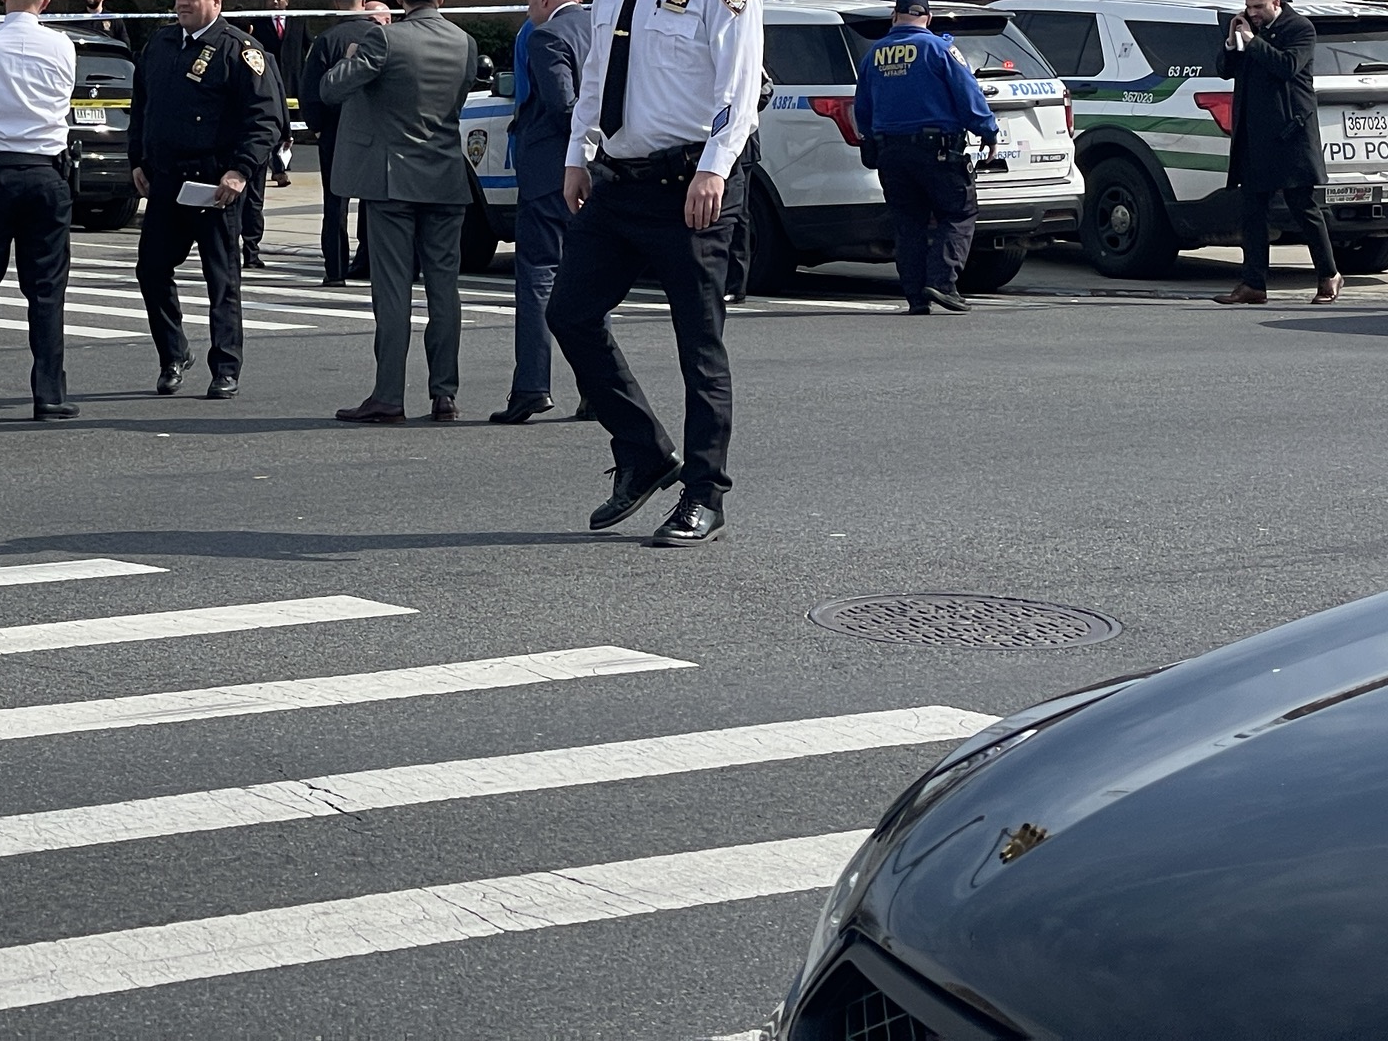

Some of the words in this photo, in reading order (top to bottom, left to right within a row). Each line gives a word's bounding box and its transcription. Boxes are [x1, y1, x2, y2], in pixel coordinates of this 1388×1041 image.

[874, 44, 918, 66] NYPD
[1167, 66, 1181, 77] 63
[1182, 66, 1202, 77] PCT
[1008, 82, 1056, 96] POLICE
[1122, 91, 1153, 104] 367023
[1347, 116, 1387, 131] 367023
